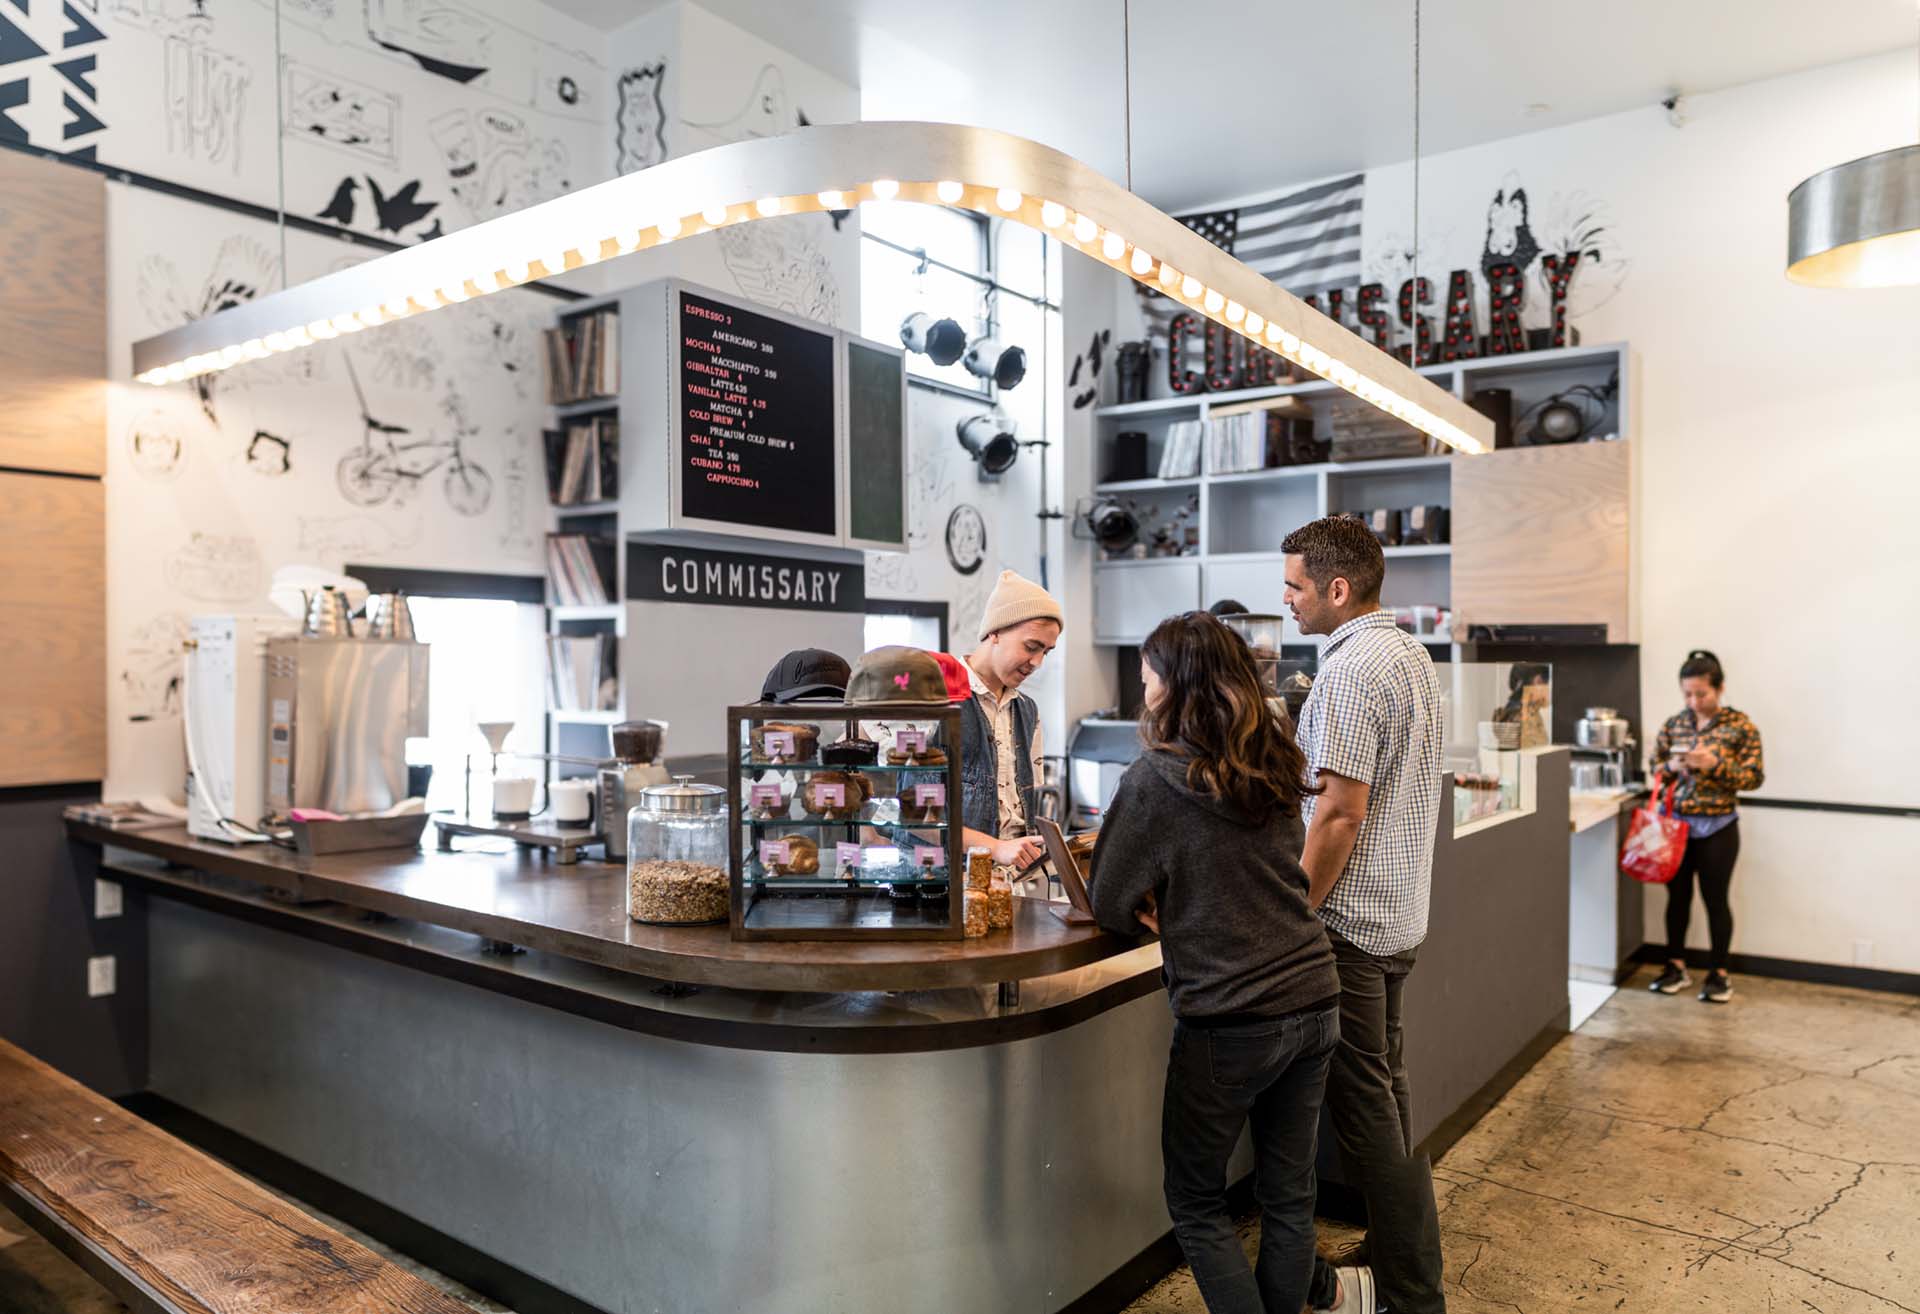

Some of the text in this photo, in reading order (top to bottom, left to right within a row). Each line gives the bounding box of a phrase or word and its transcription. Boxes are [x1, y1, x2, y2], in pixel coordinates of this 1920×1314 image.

[685, 304, 724, 322] ESPRESSO
[1168, 254, 1581, 393] COSSARY
[685, 337, 715, 353] MOCHA
[712, 330, 757, 350] AMERICANO
[686, 361, 730, 379] GIBRALTAR
[711, 355, 760, 375] MACCHIATTO
[711, 378, 734, 391] LATTE
[688, 384, 720, 398] VANILLA
[724, 392, 748, 406] LATTE
[689, 409, 710, 420] COLD
[713, 414, 733, 425] BREW
[710, 402, 743, 417] MATCHA
[690, 435, 711, 445] CHAI
[709, 426, 745, 440] PREMIUM
[746, 434, 765, 444] COLD
[768, 438, 787, 448] BREW
[708, 449, 723, 459] TEA
[690, 457, 724, 470] CUBANO
[706, 472, 754, 488] CAPPUCCINO
[662, 556, 841, 604] COMMISSARY
